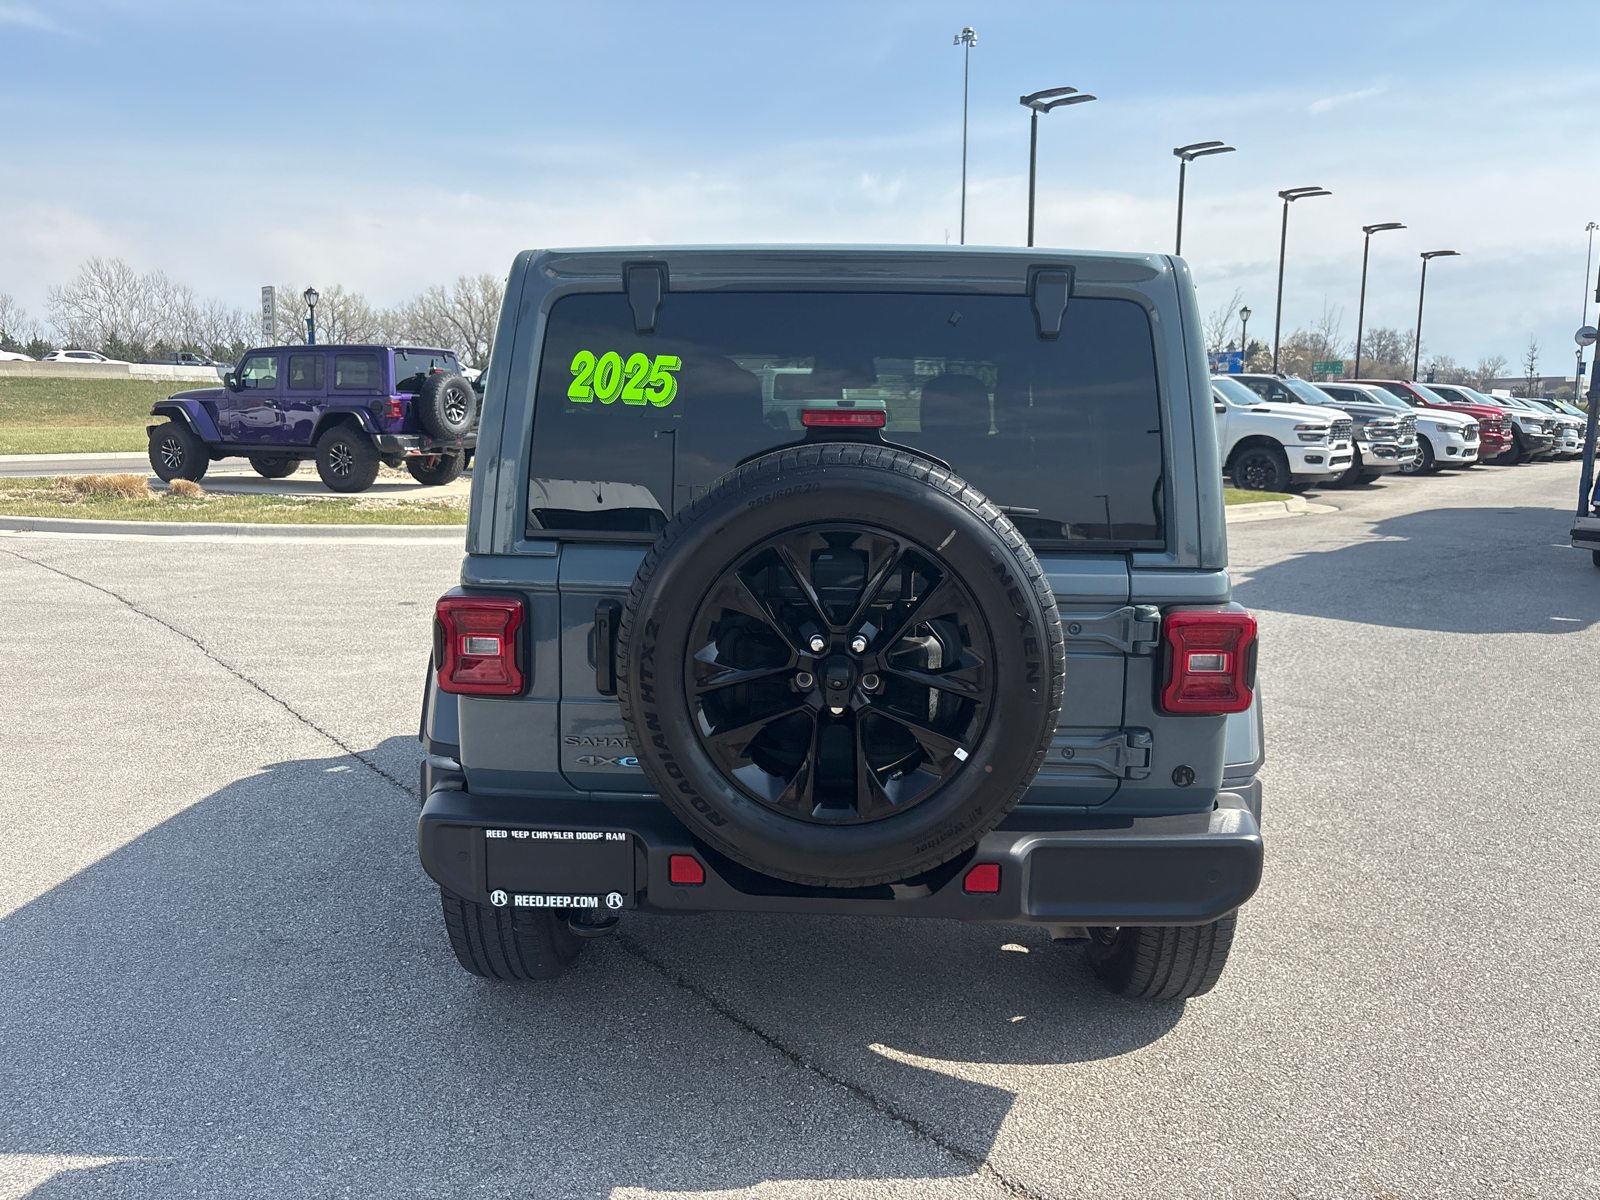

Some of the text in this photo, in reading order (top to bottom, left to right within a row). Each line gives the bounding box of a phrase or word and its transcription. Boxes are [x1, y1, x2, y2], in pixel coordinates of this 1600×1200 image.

[567, 350, 682, 408] 2025
[991, 562, 1041, 684] NEXEN
[644, 710, 729, 827] ROADIAN
[485, 829, 508, 839] REED
[531, 831, 574, 840] CHRYSLER
[605, 832, 626, 842] RAM
[514, 894, 599, 908] REEDJEEP.COM
